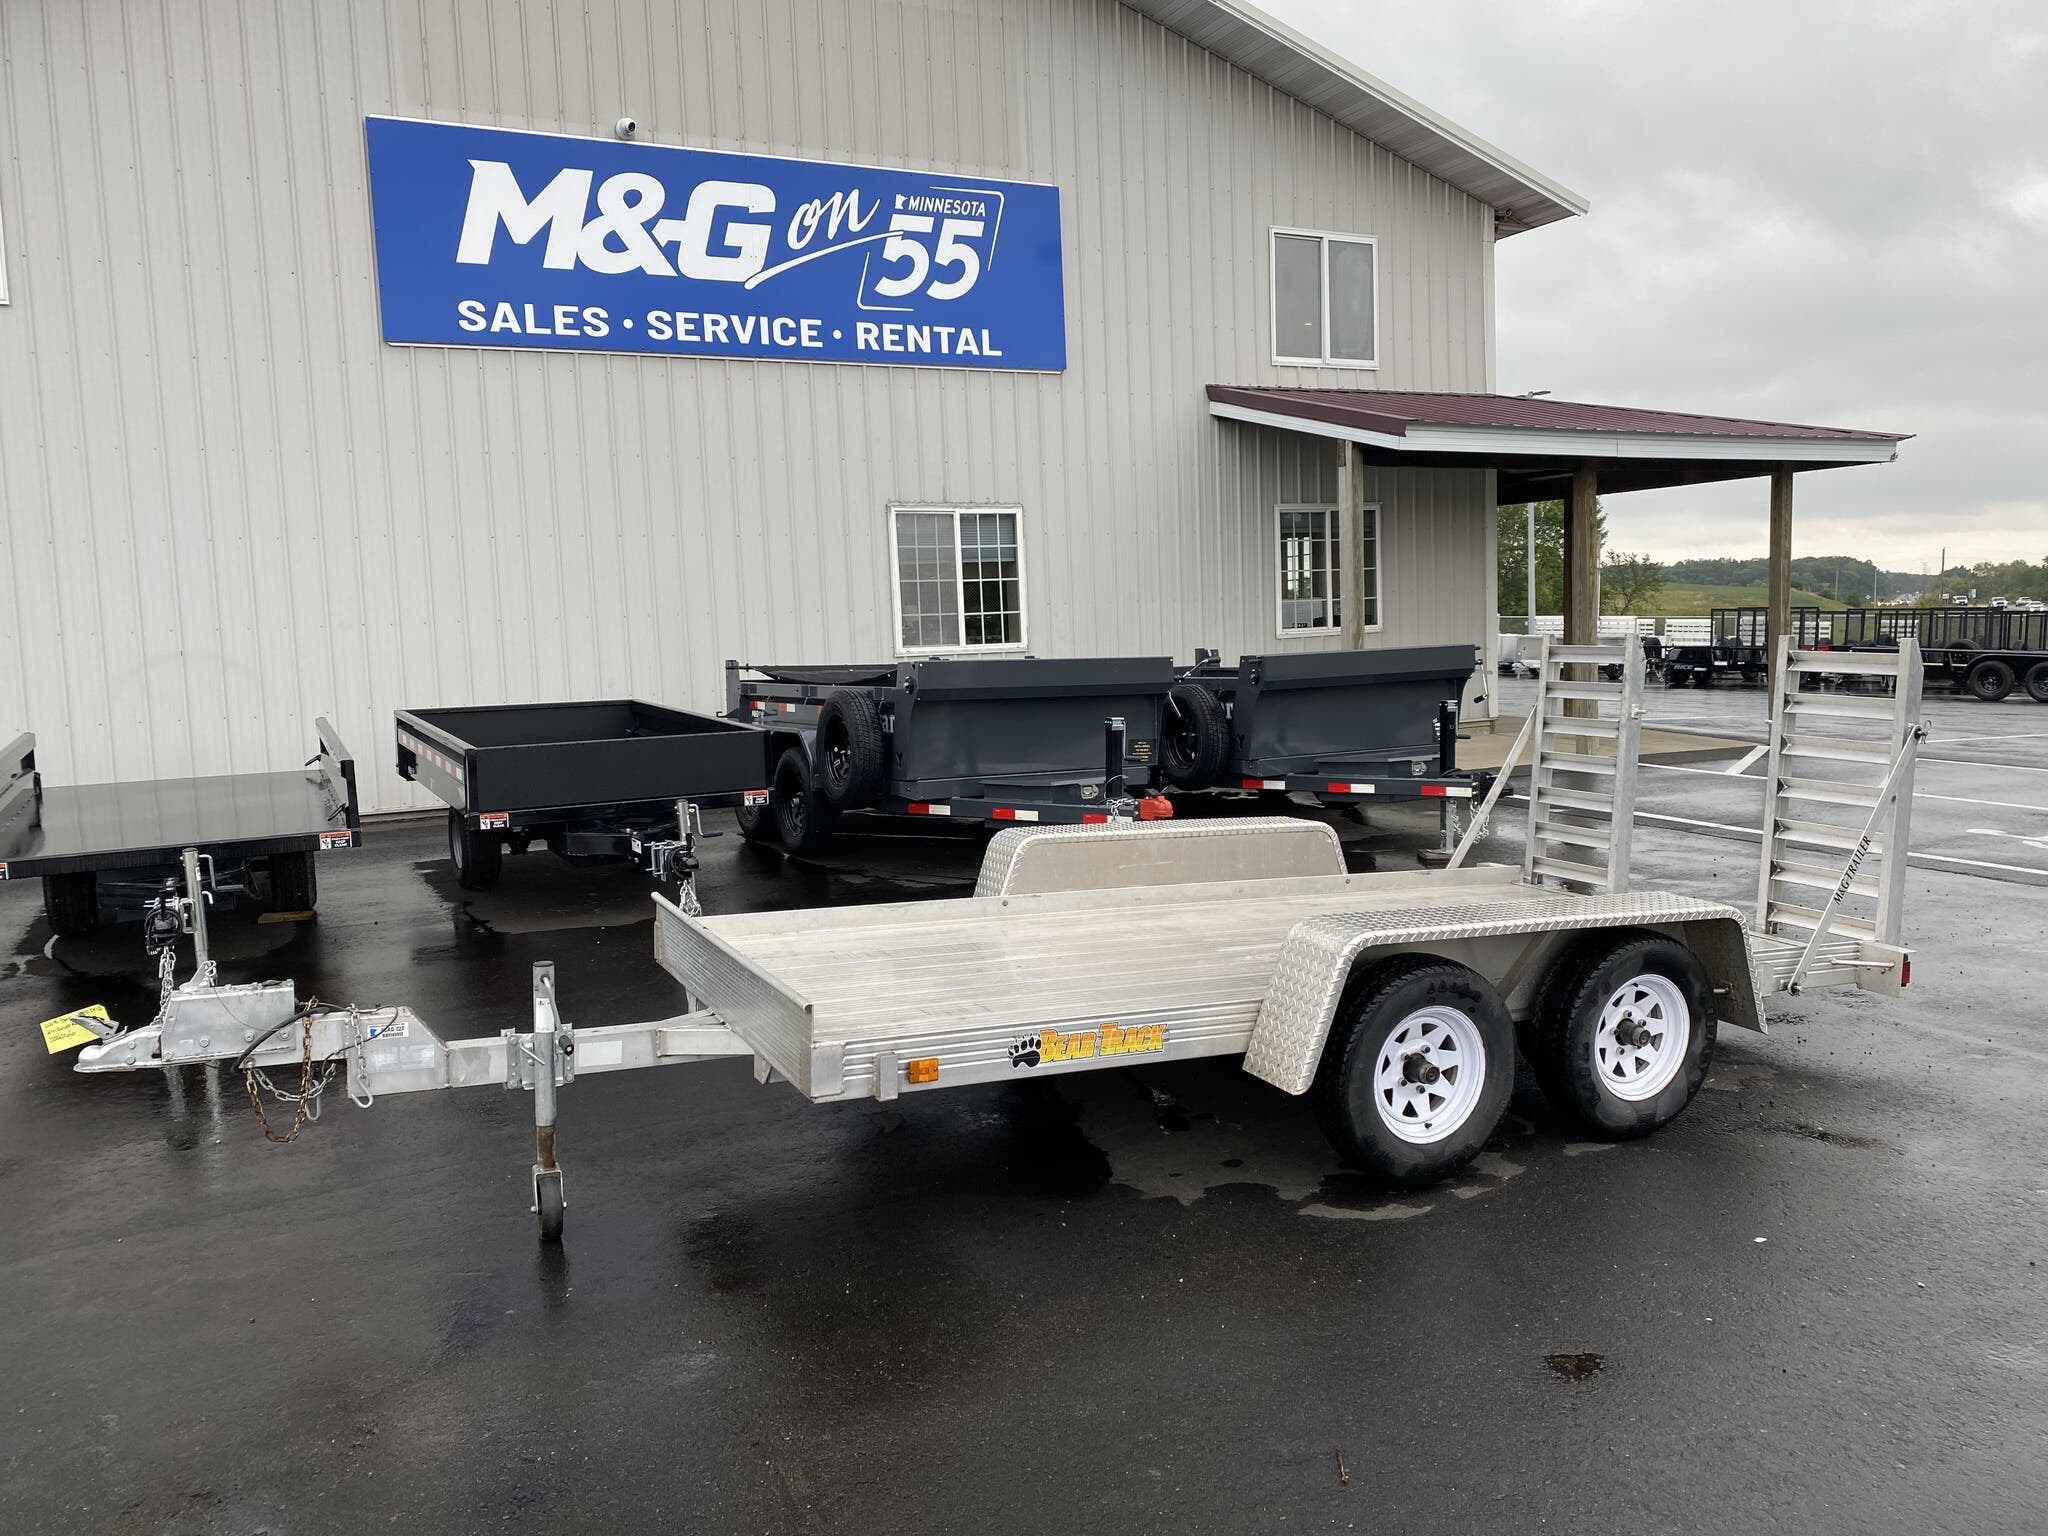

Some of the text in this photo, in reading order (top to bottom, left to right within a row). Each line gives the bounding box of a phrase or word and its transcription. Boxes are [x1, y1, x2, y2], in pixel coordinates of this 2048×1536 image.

[456, 159, 881, 283] M&G on
[908, 194, 986, 217] MINNESOTA
[873, 213, 986, 301] 55
[457, 300, 1003, 357] SALES SERVICE RENTAL
[1844, 835, 1872, 880] TRAILER
[1039, 1022, 1167, 1063] BEAR TRACK
